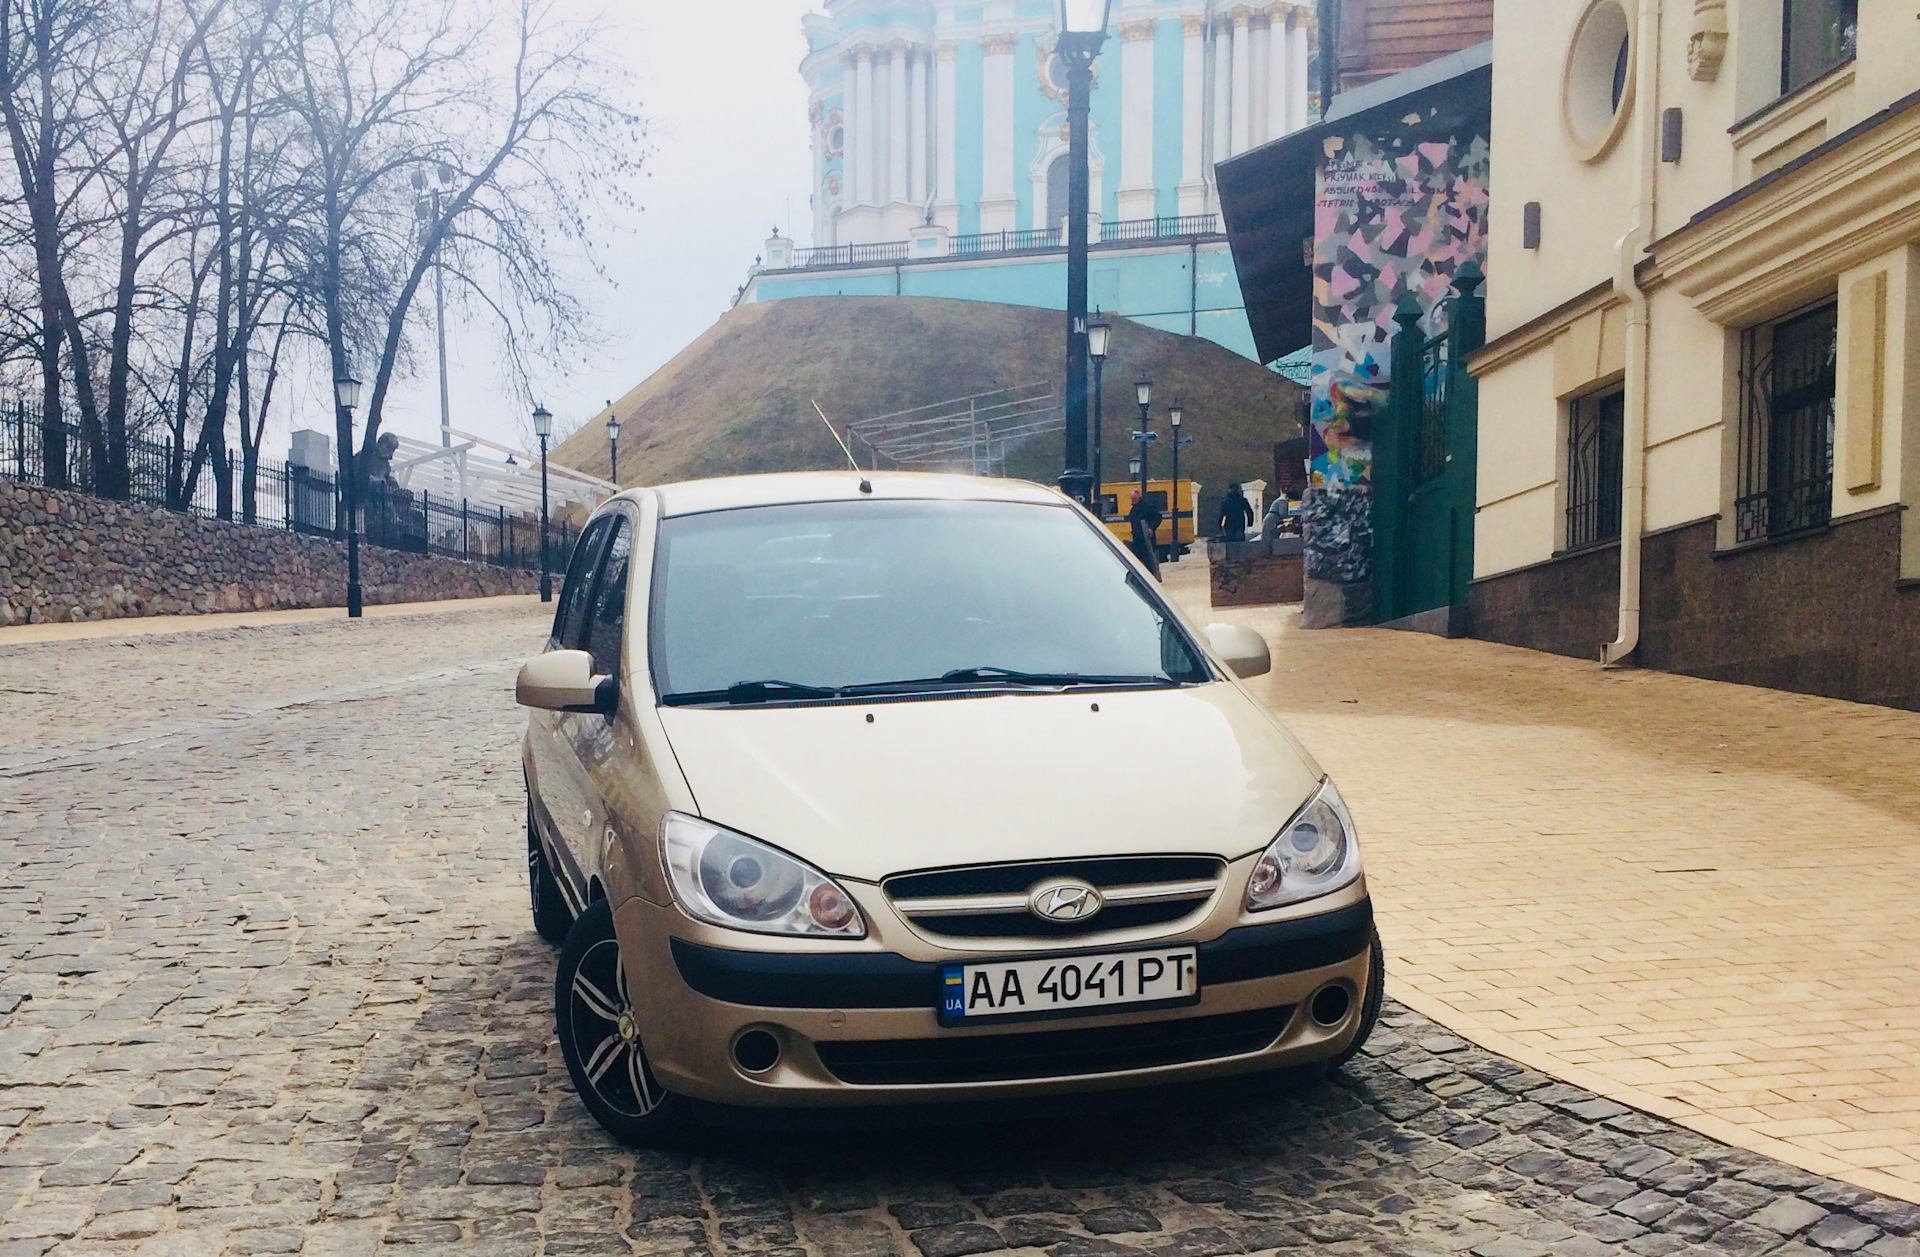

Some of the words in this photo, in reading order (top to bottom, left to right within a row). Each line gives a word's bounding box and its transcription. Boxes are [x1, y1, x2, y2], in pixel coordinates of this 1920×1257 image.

[968, 969, 1026, 1009] AA
[1037, 960, 1125, 1003] 4041
[1137, 953, 1193, 995] PT
[945, 999, 963, 1011] UA
